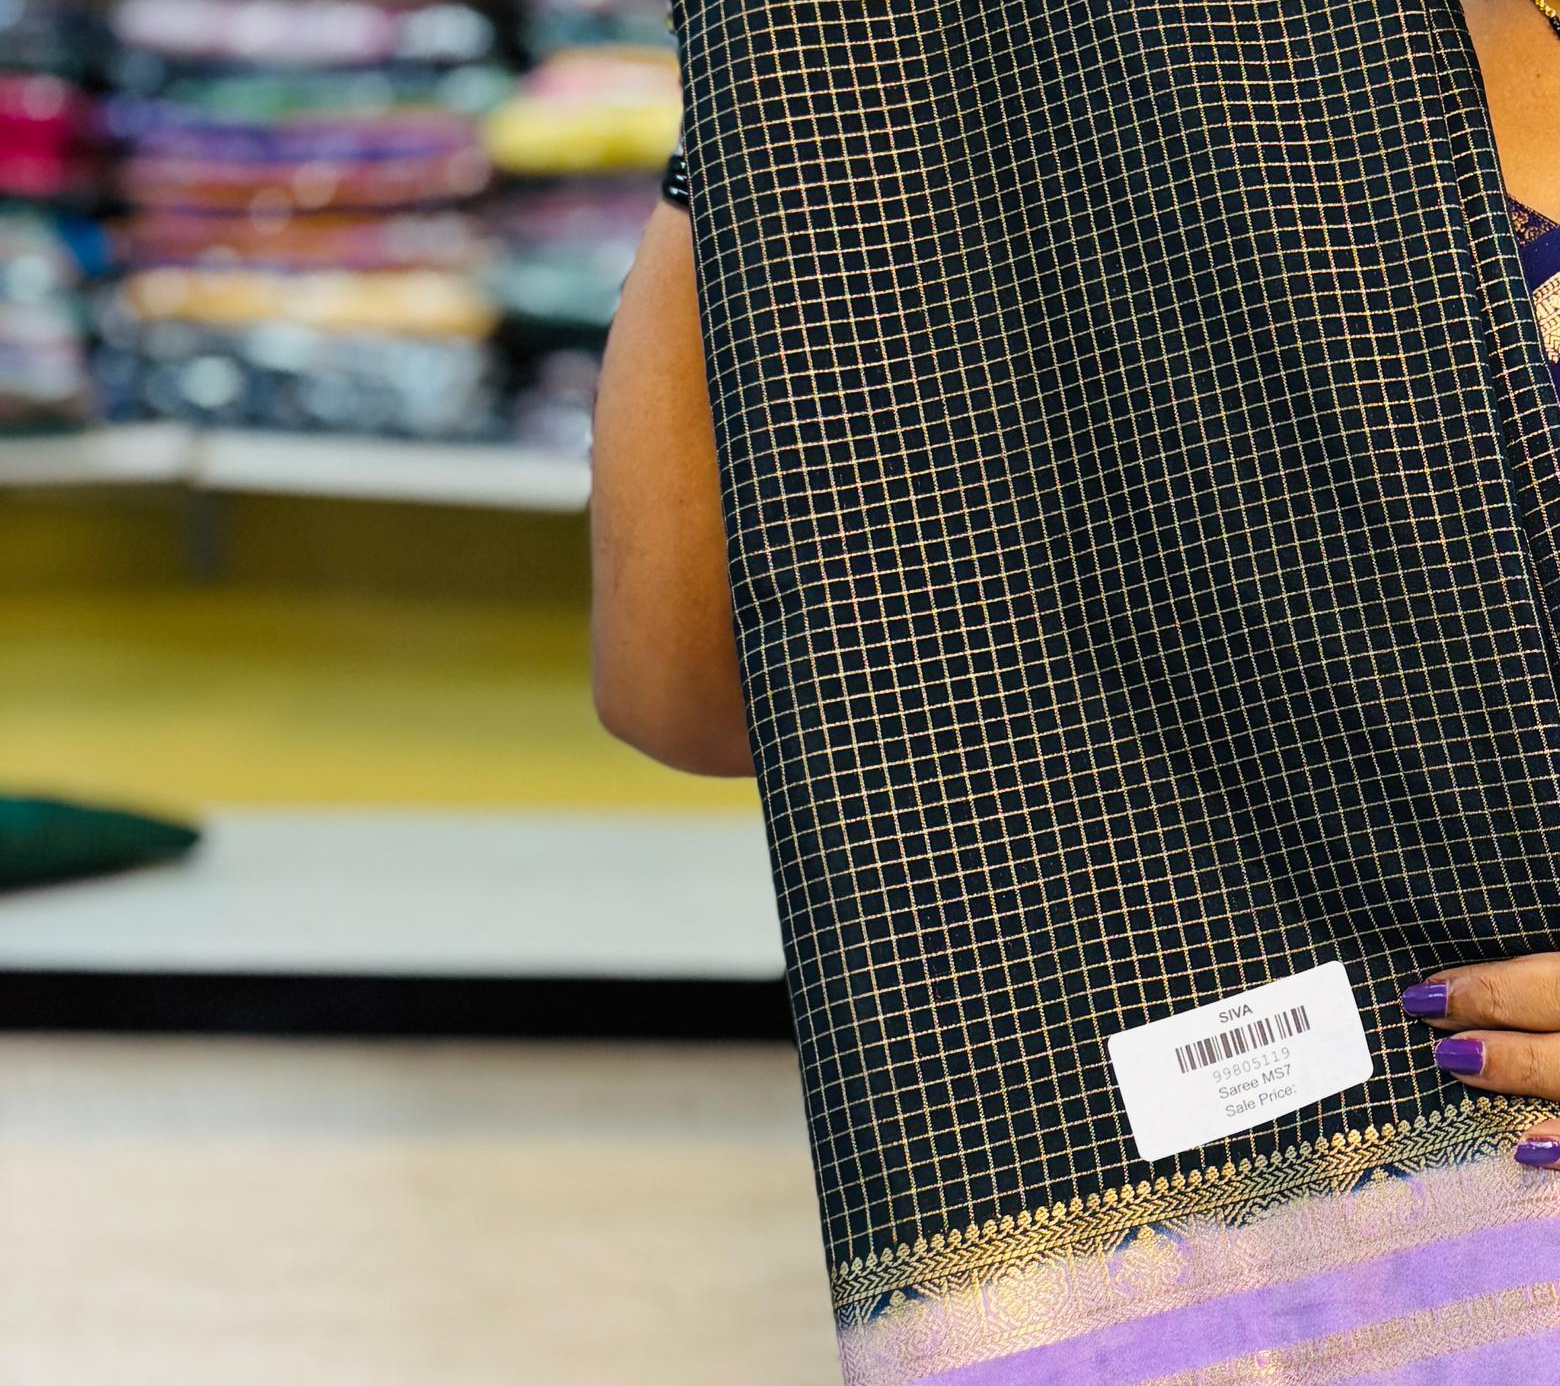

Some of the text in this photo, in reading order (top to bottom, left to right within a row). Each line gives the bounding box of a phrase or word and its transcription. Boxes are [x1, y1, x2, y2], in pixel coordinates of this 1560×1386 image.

[1218, 1004, 1253, 1023] SIVA
[1212, 1046, 1291, 1084] 99805119
[1218, 1063, 1292, 1100] Saree MS7
[1225, 1083, 1297, 1117] Sale Price:
